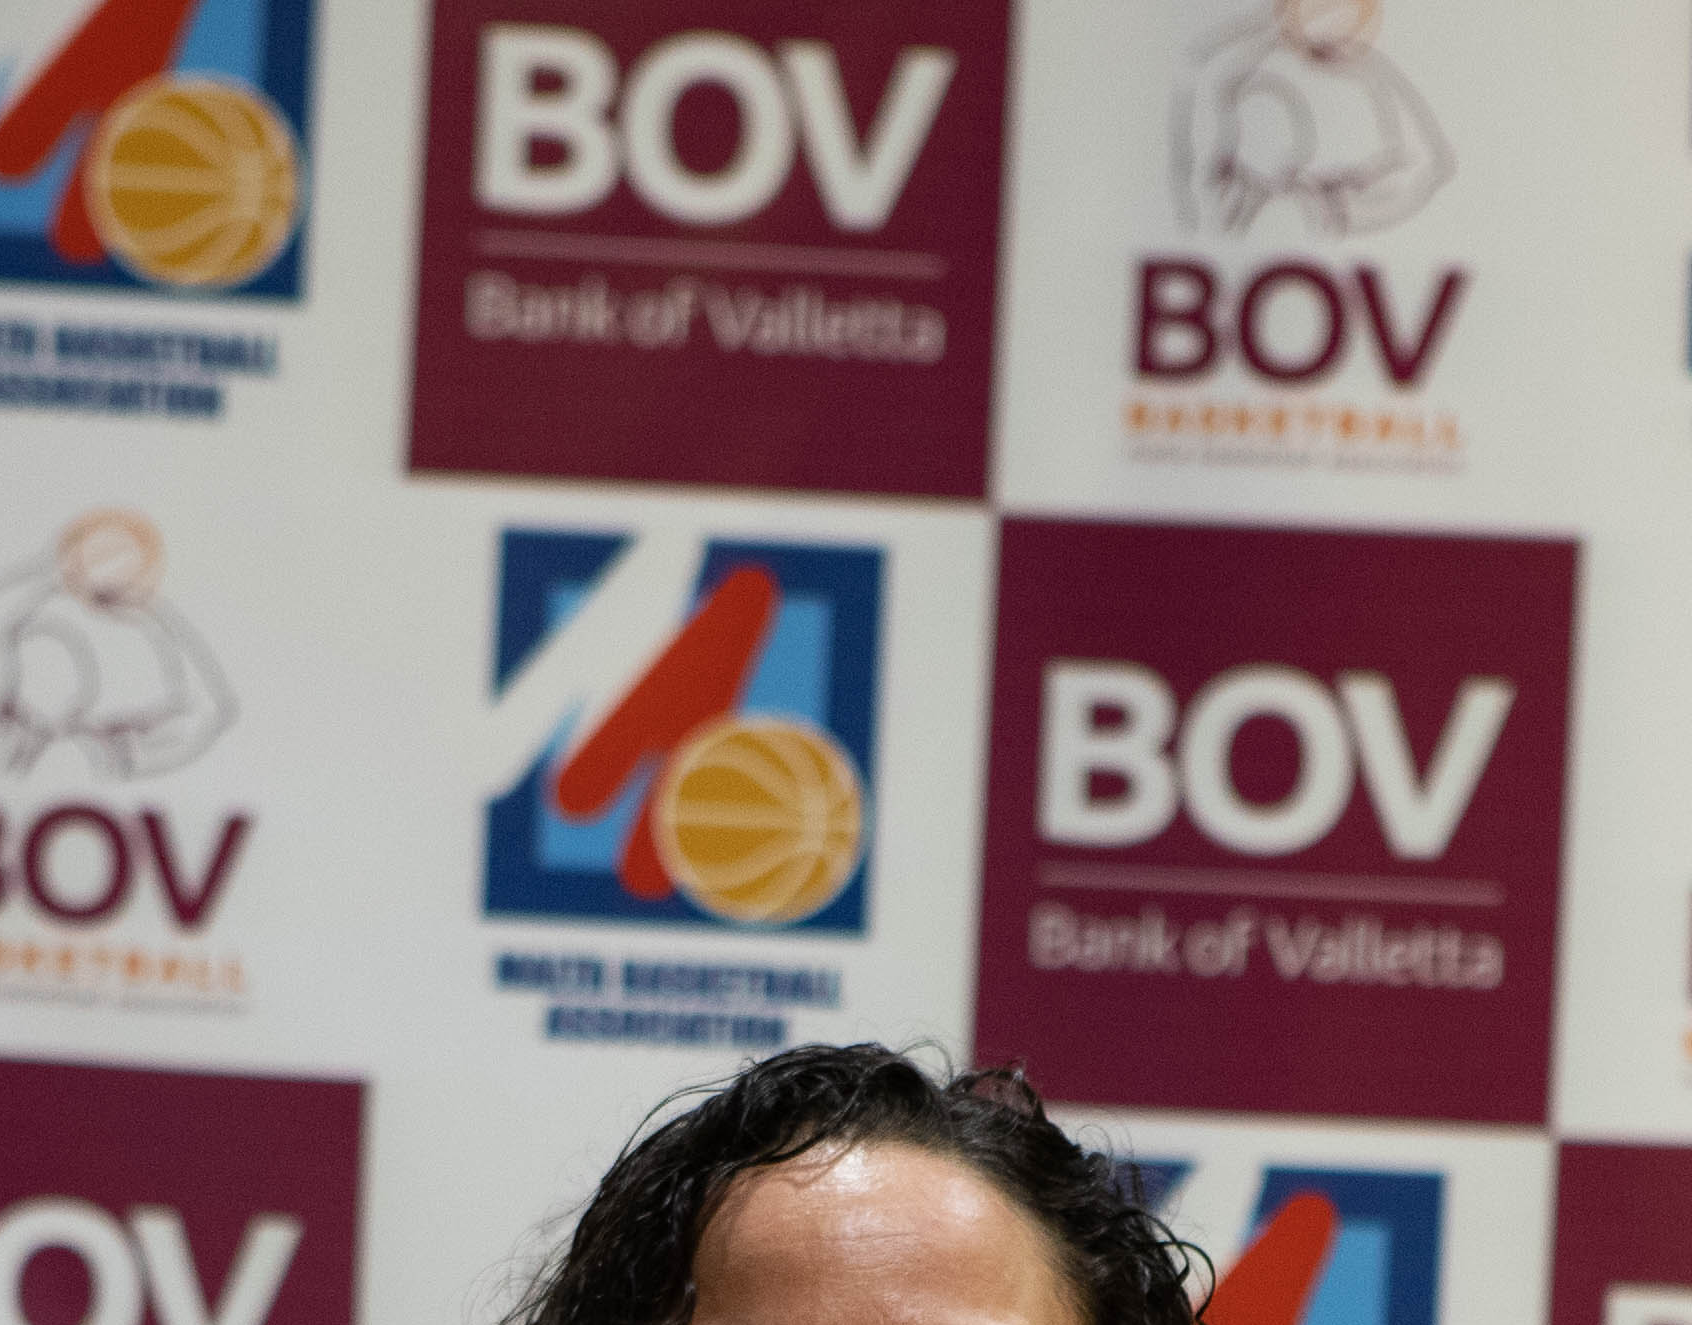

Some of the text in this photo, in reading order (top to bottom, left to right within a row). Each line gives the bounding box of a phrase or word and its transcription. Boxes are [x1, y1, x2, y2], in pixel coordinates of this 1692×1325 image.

[475, 24, 956, 230] BOV
[466, 272, 948, 364] Bank of Valletta
[1134, 255, 1473, 389] BOV
[1036, 658, 1518, 861] BOV
[1029, 903, 1505, 990] Bank of Valletta
